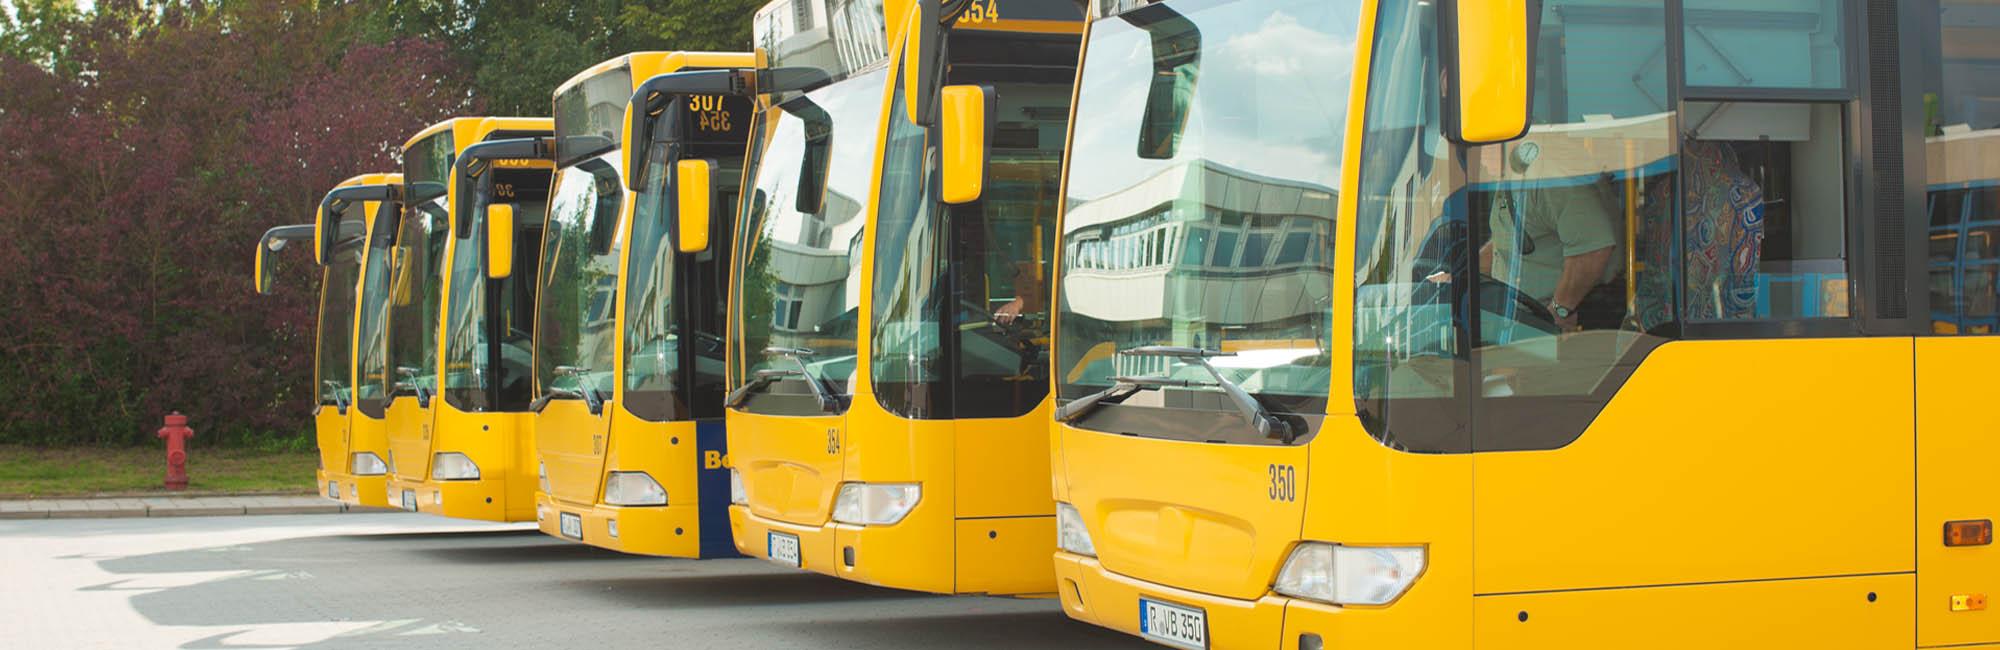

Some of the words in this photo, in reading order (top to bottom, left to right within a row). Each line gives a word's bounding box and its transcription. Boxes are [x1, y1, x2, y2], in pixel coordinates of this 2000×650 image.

[827, 429, 840, 454] 354
[1269, 463, 1295, 502] 350
[1150, 606, 1157, 632] R
[1164, 609, 1178, 636] VB
[1180, 613, 1202, 642] 350
